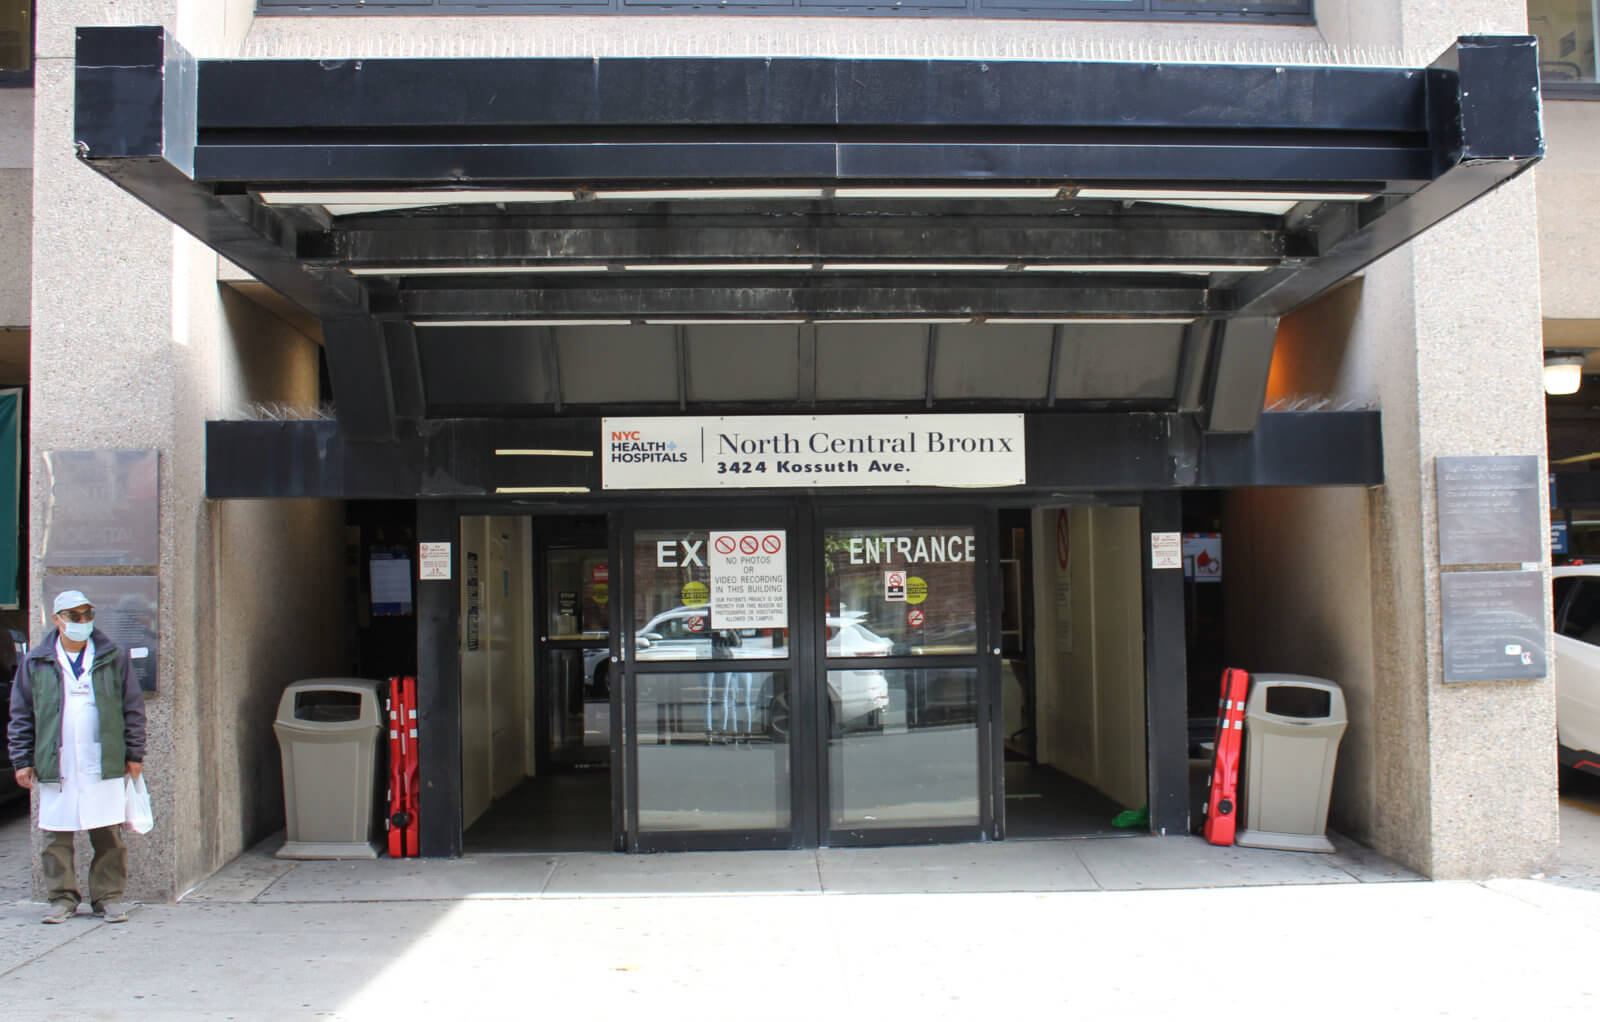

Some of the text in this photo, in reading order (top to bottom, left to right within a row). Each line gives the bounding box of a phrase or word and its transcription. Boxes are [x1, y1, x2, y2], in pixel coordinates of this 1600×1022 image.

[611, 431, 641, 441] NYC
[717, 432, 1013, 455] North Central Bronx
[611, 452, 688, 463] HOSPITALS
[717, 460, 911, 474] 3424 Kossuth Ave.
[850, 536, 976, 564] ENTRANCE
[740, 556, 772, 564] PHOTOS
[743, 566, 754, 574] OR
[715, 575, 783, 584] VIDEO RECORDING
[728, 585, 744, 593] THIS
[748, 585, 783, 593] BUILDING
